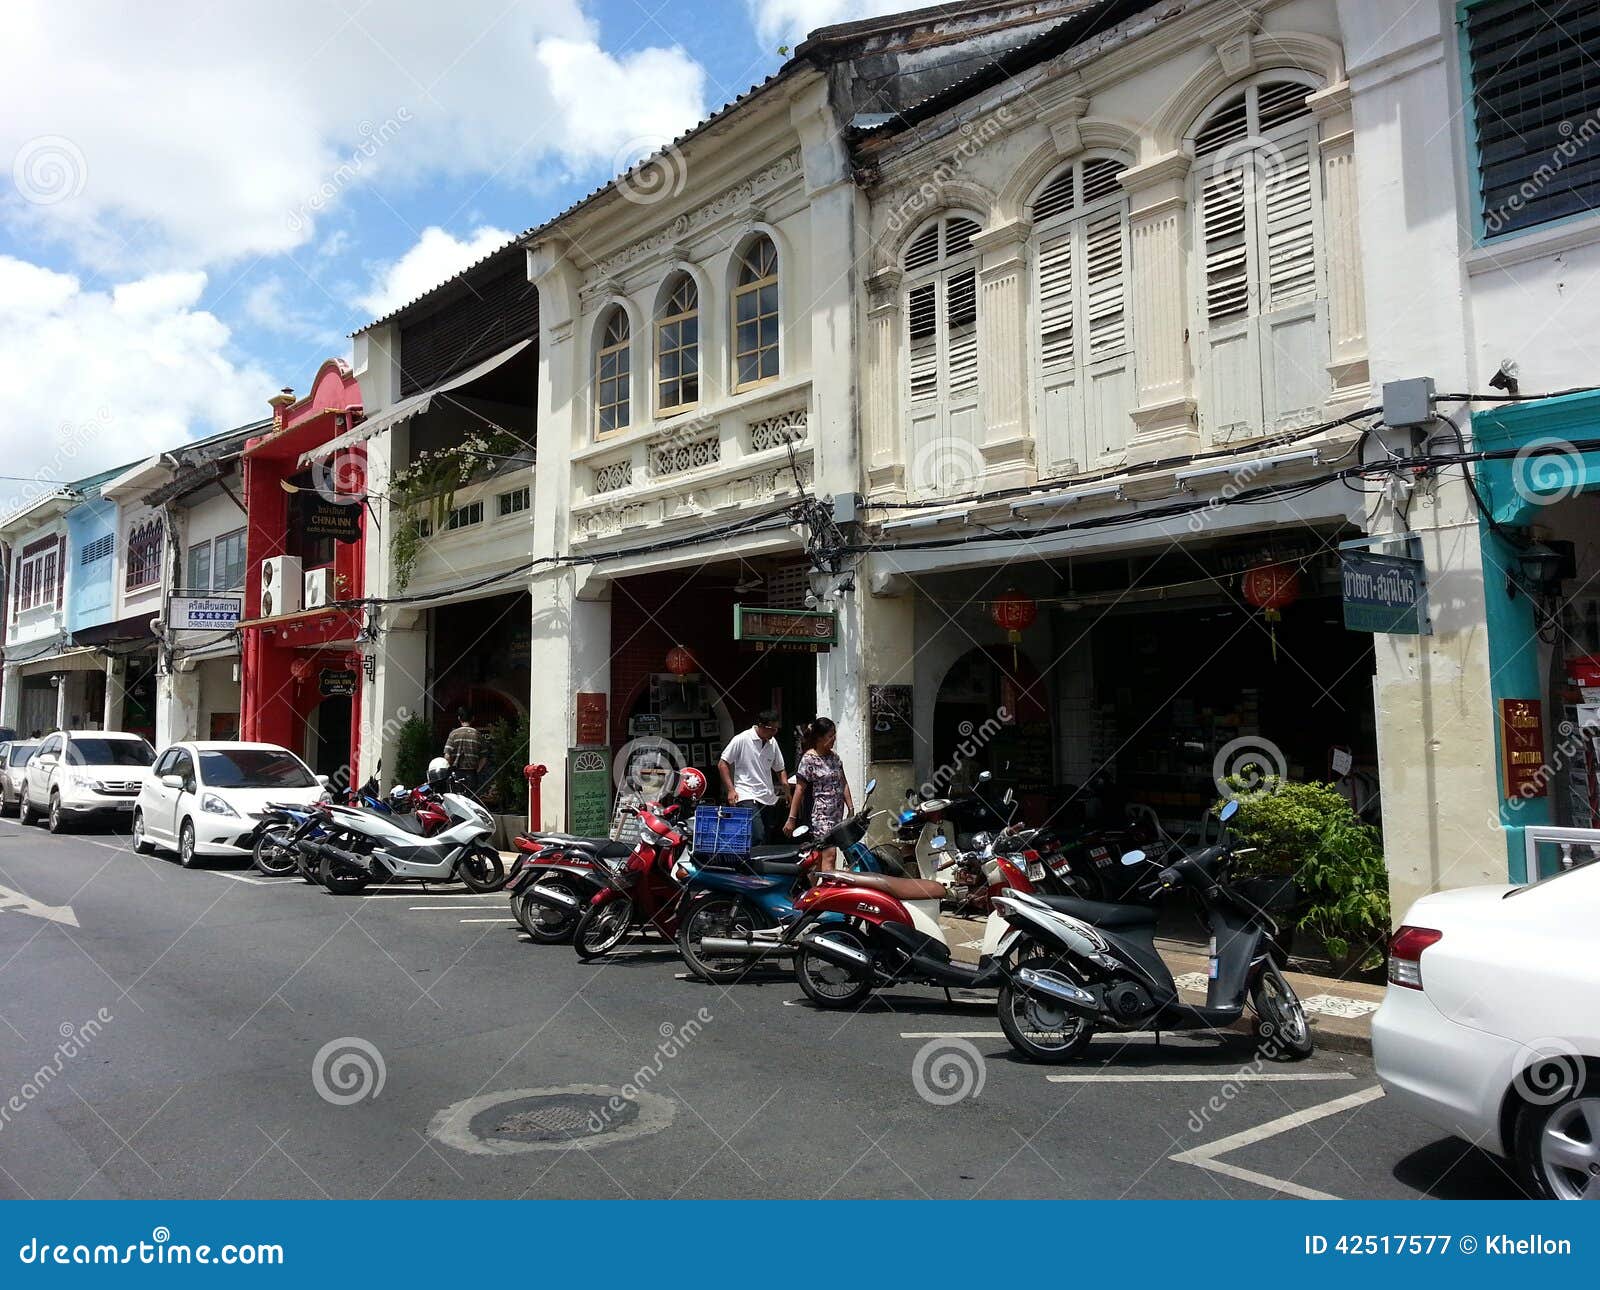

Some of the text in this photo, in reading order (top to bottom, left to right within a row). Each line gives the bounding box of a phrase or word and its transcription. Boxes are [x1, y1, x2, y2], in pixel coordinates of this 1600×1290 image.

[311, 514, 352, 527] CHINA INN
[189, 620, 213, 628] CHRISTIAN
